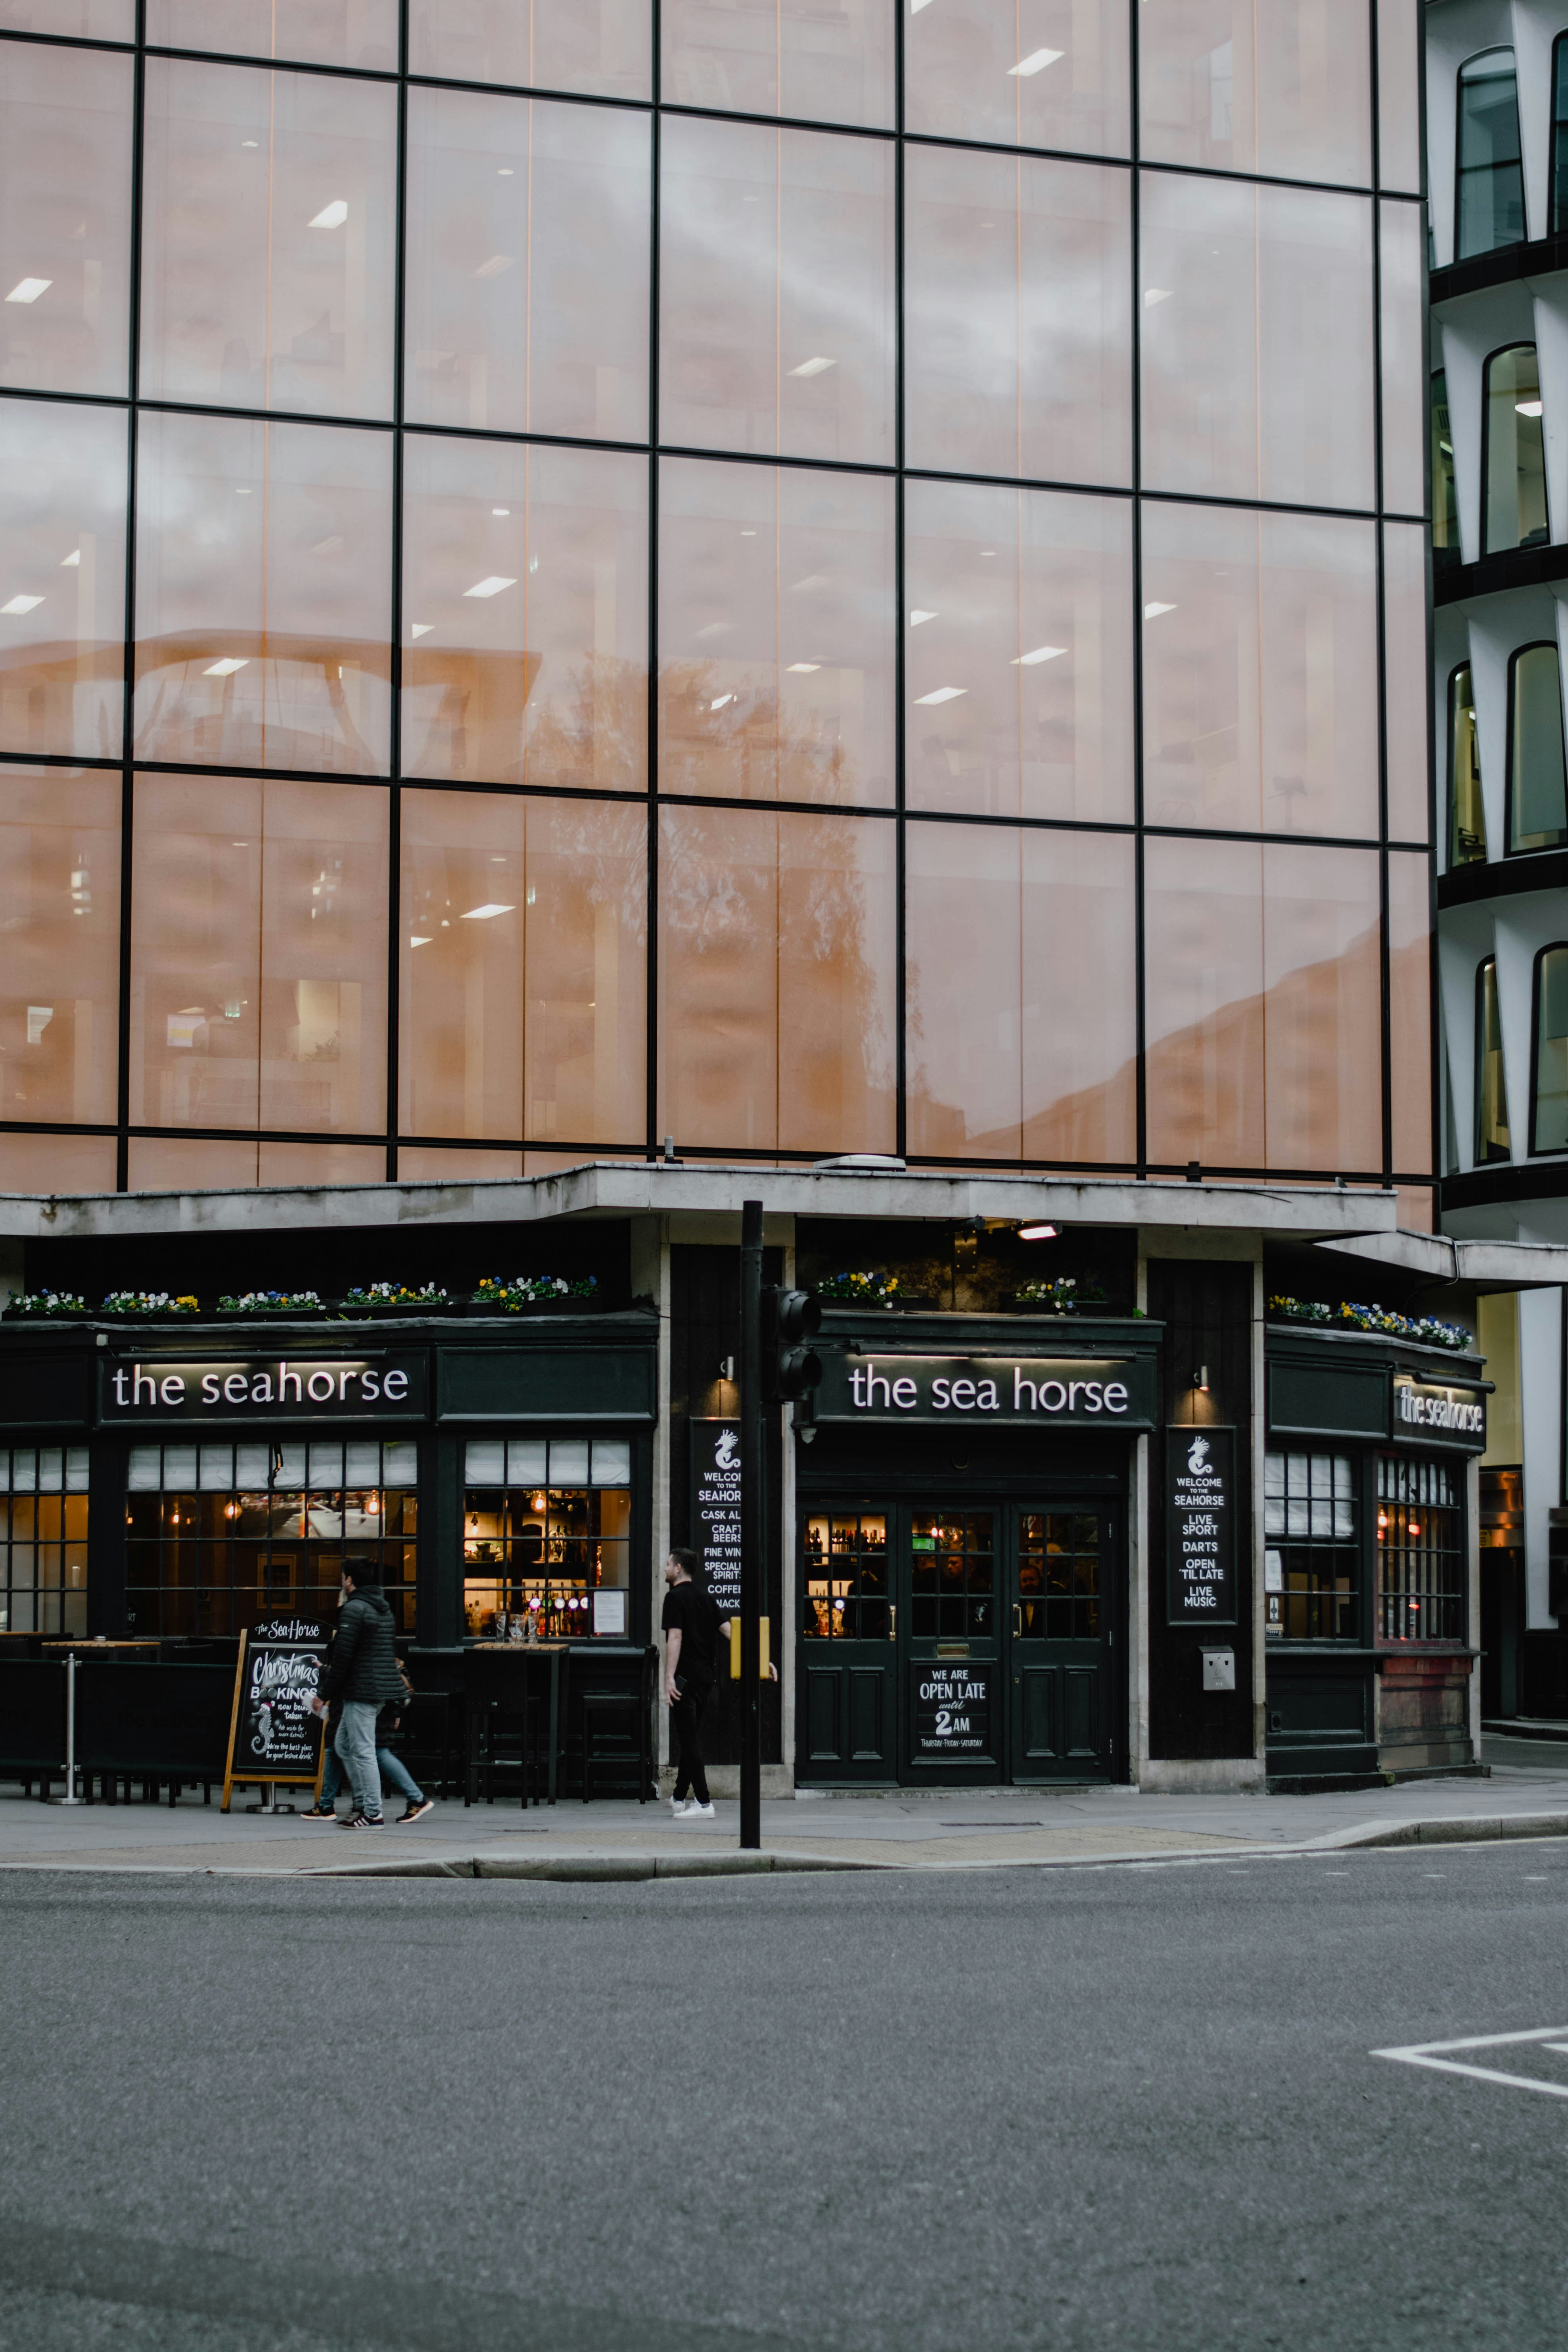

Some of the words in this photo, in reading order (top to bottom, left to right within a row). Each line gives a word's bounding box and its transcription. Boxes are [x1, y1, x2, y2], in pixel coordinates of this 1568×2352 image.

[112, 1363, 185, 1406] the
[202, 1362, 408, 1404] seahorse
[848, 1364, 917, 1408] the
[932, 1379, 999, 1410] sea
[1014, 1367, 1129, 1413] horse
[1400, 1384, 1424, 1424] the
[1426, 1390, 1483, 1432] seahorse
[703, 1472, 741, 1482] WELCO
[1177, 1478, 1222, 1487] WELCOME
[698, 1490, 741, 1501] SEAHOR
[1174, 1495, 1224, 1506] SEAHORSE
[701, 1510, 726, 1520] CASK
[728, 1510, 741, 1520] AL
[1189, 1514, 1212, 1525] LIVE
[1183, 1524, 1218, 1535] SPORT
[704, 1547, 723, 1556] FINE
[724, 1547, 741, 1557] WIN
[1183, 1541, 1218, 1552] DARTS
[1186, 1558, 1215, 1569] OPEN
[1199, 1569, 1223, 1580] LATE
[1189, 1586, 1212, 1597] LIVE
[716, 1599, 741, 1608] NACK
[1184, 1597, 1217, 1607] MUSIC
[255, 1623, 269, 1635] The
[253, 1651, 320, 1685] Christmas
[932, 1670, 947, 1680] WE
[950, 1670, 969, 1680] ARE
[920, 1683, 953, 1699] OPEN
[958, 1683, 986, 1699] LATE
[938, 1700, 966, 1710] until
